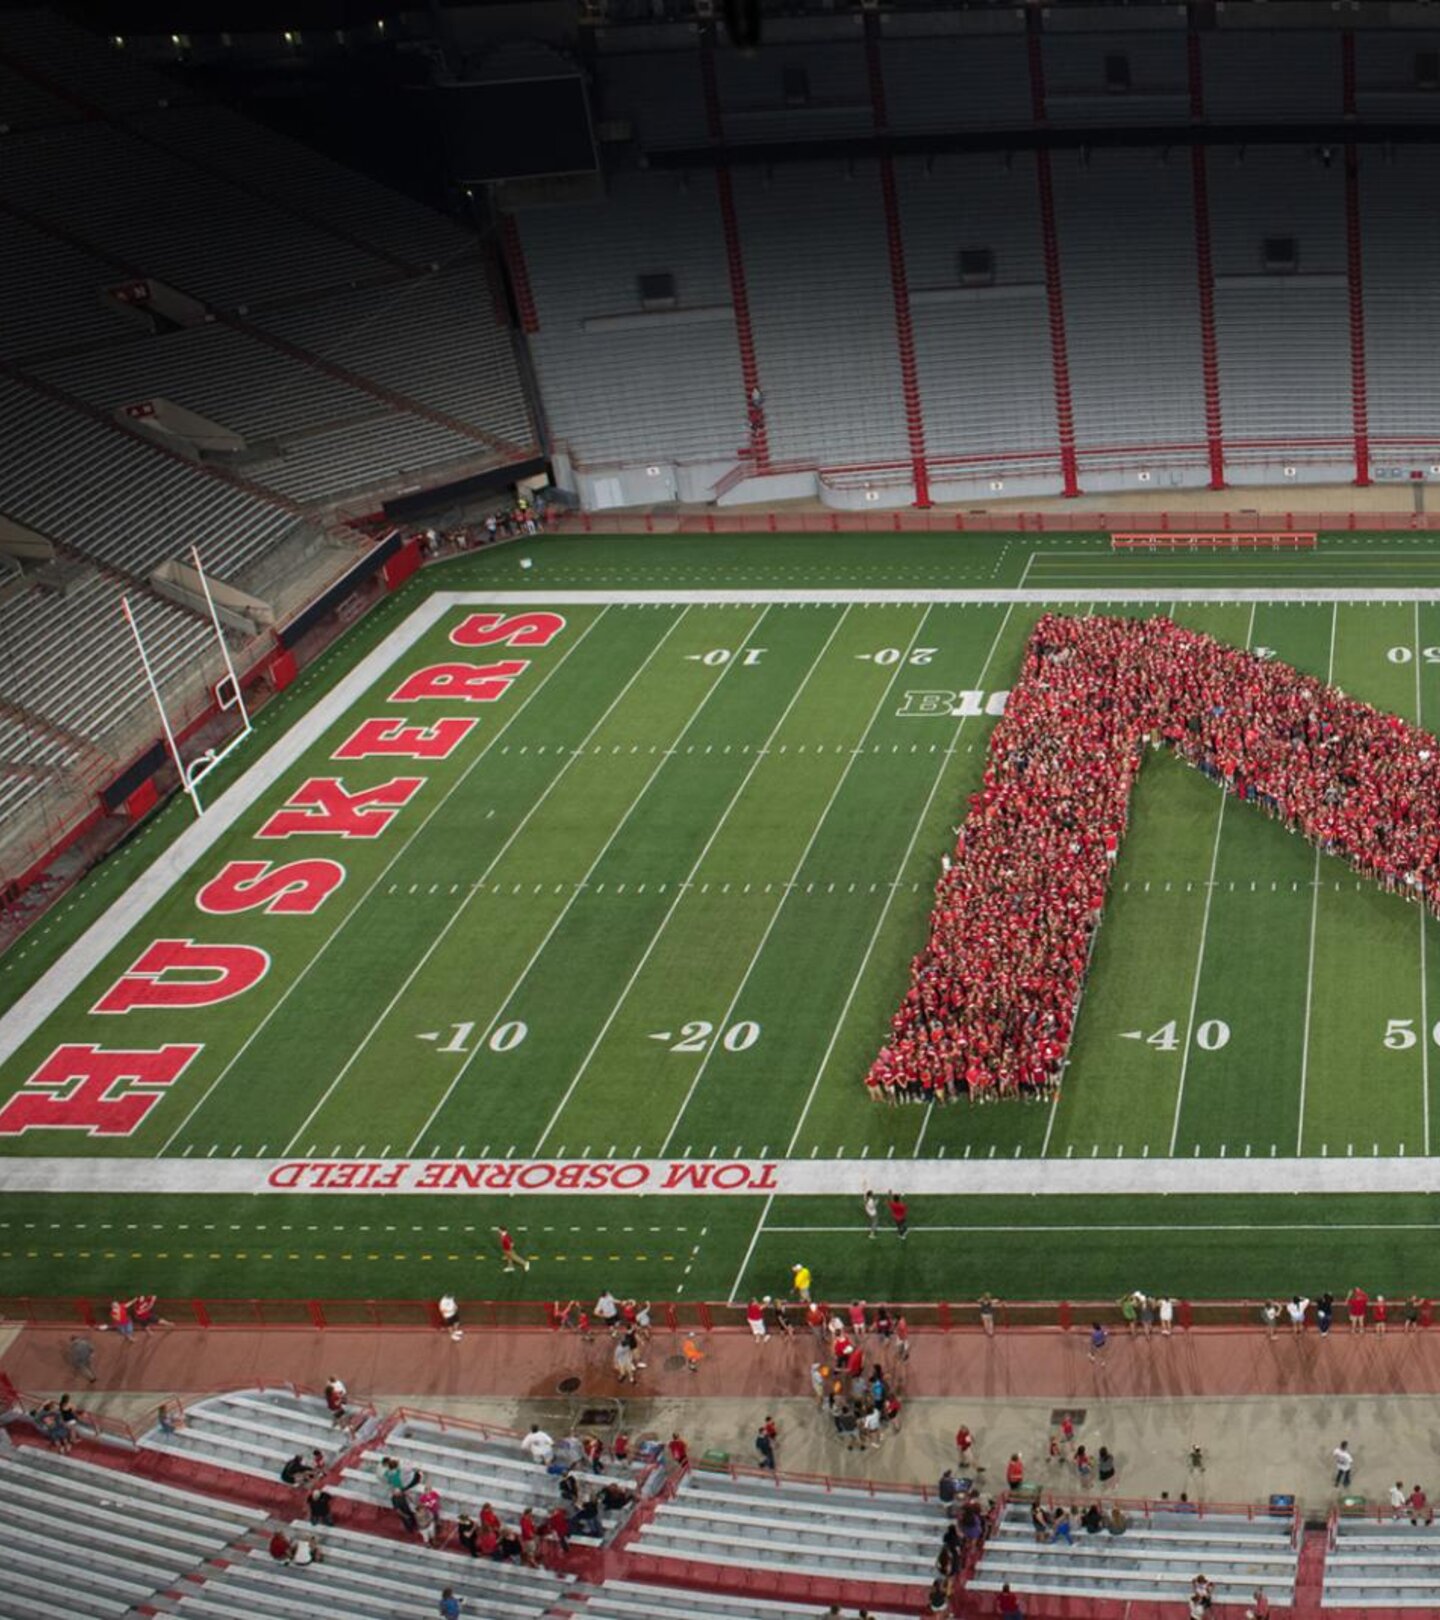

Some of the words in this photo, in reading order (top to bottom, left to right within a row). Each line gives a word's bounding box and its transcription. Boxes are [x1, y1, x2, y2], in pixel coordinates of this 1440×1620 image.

[0, 611, 566, 1137] HUSKERS
[268, 1163, 411, 1188] FIELD
[416, 1163, 651, 1188] OSBORNE
[661, 1163, 778, 1188] TOM
